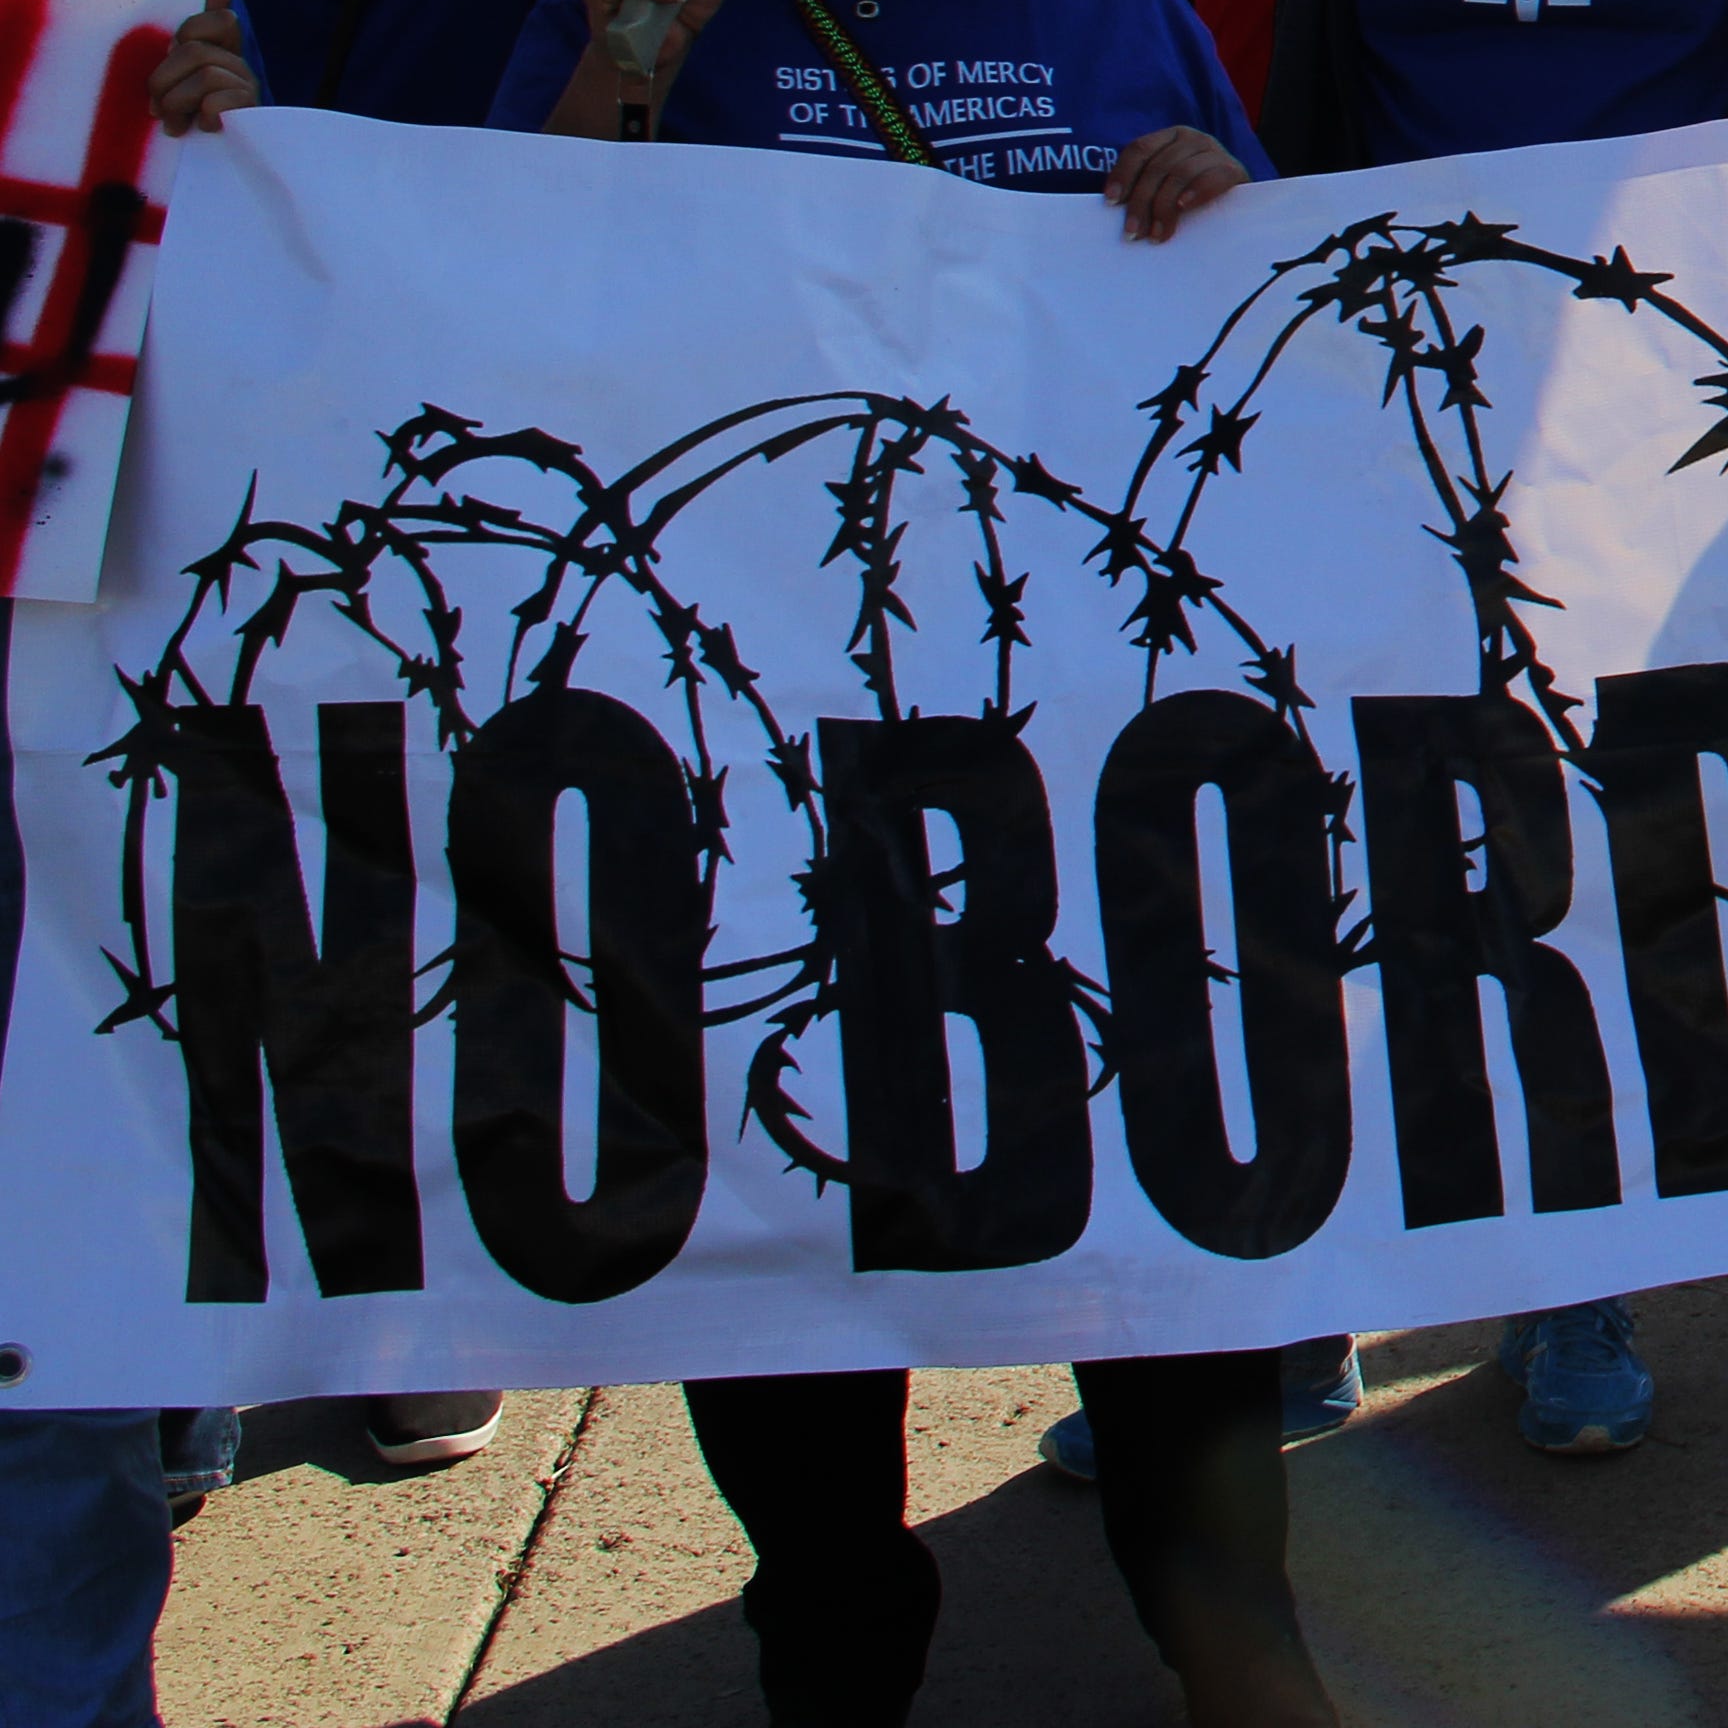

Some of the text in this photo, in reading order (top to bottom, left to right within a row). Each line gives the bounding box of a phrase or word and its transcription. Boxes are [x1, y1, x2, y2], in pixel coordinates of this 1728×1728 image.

[907, 62, 947, 90] OF
[957, 60, 1055, 87] MERCY
[789, 102, 829, 124] OF
[165, 688, 708, 1306] NO
